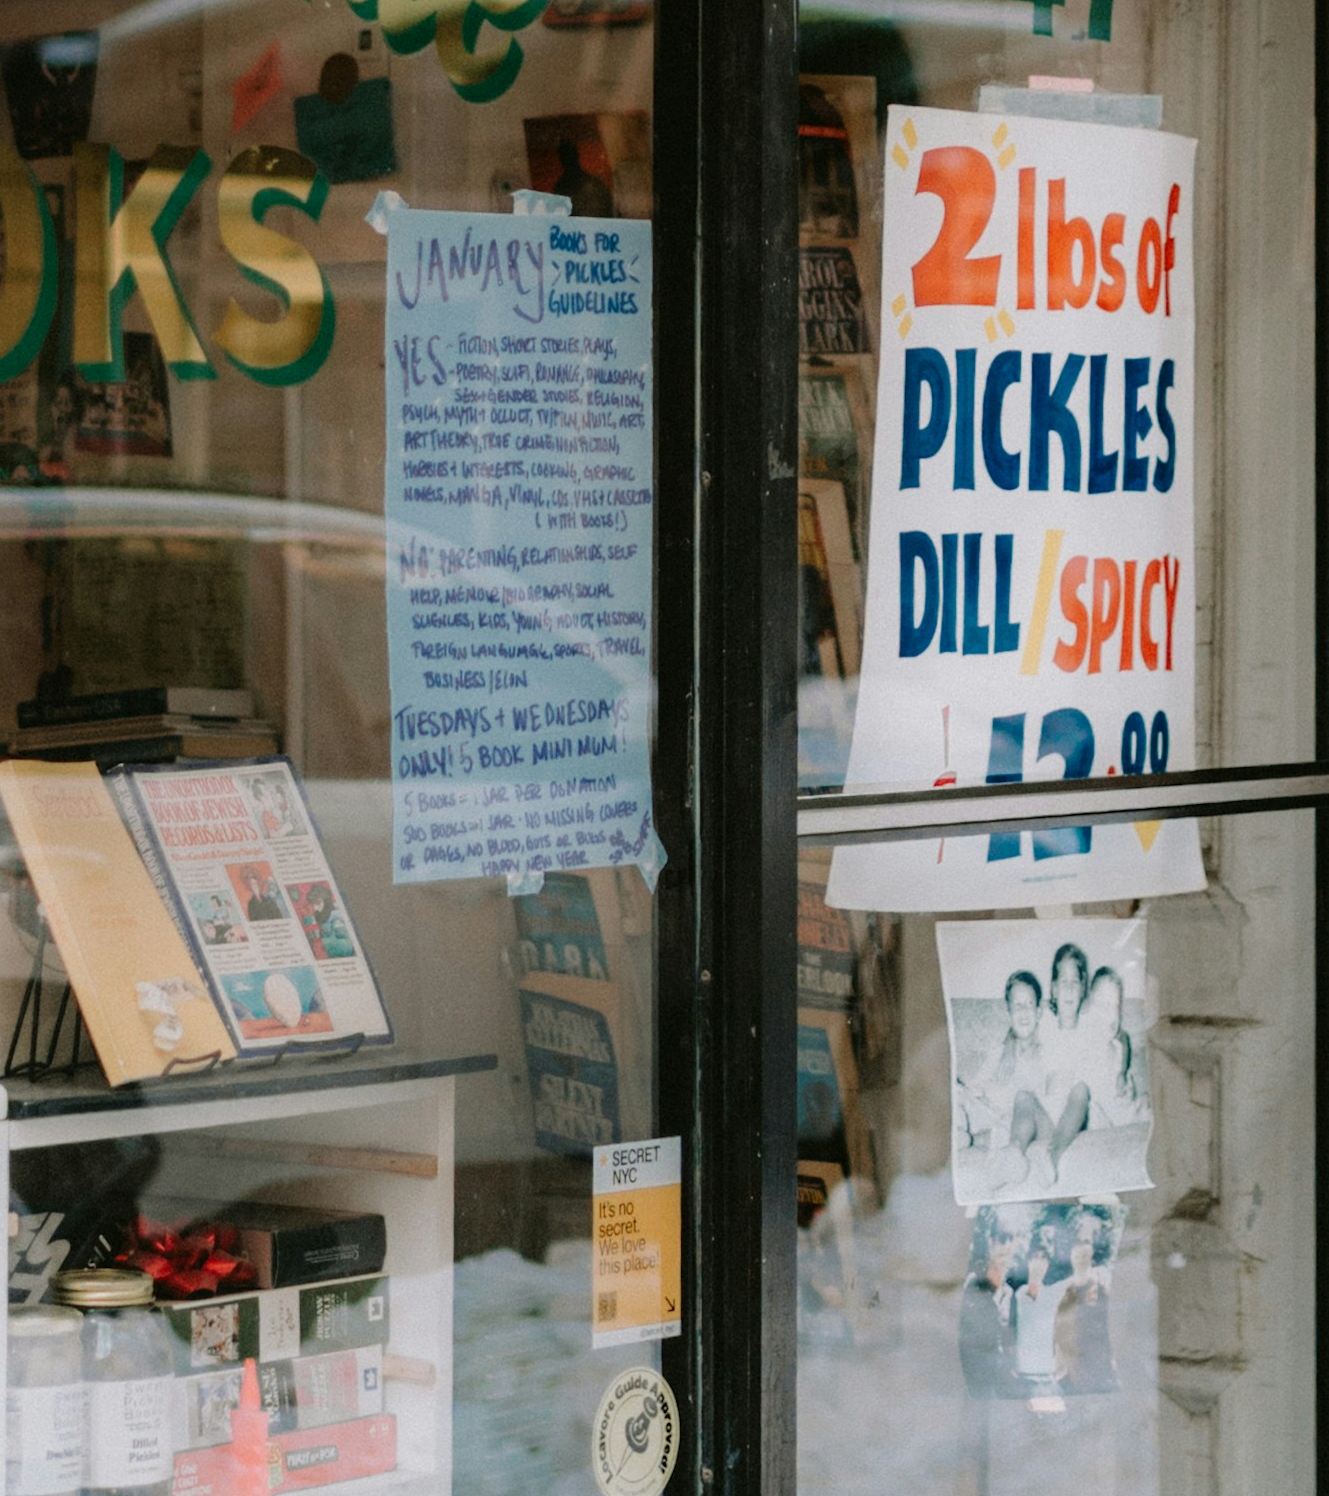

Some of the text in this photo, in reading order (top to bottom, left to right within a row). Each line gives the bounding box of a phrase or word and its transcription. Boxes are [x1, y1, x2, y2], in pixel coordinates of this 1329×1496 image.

[549, 224, 621, 255] BOOKS FOR
[911, 145, 1182, 318] 2 lbs of
[395, 226, 544, 323] JANUARY
[565, 260, 628, 284] PICKLES
[548, 290, 639, 316] GUIDELINES
[394, 335, 448, 395] YES
[898, 346, 1177, 495] PICKLES
[394, 705, 492, 742] TUESDAYS
[513, 698, 630, 734] WEDNESDAYS
[398, 744, 454, 779] ONLY!
[460, 740, 473, 773] 5
[478, 744, 524, 769] BOOK
[550, 774, 617, 798] DONATION
[612, 1145, 661, 1168] SECRET
[612, 1167, 638, 1186] NYC
[599, 1201, 634, 1219] It's no
[598, 1219, 641, 1239] secret.
[599, 1236, 646, 1257] We love
[599, 1252, 660, 1277] this place!
[599, 1400, 616, 1485] Locavore
[614, 1374, 649, 1400] Guide
